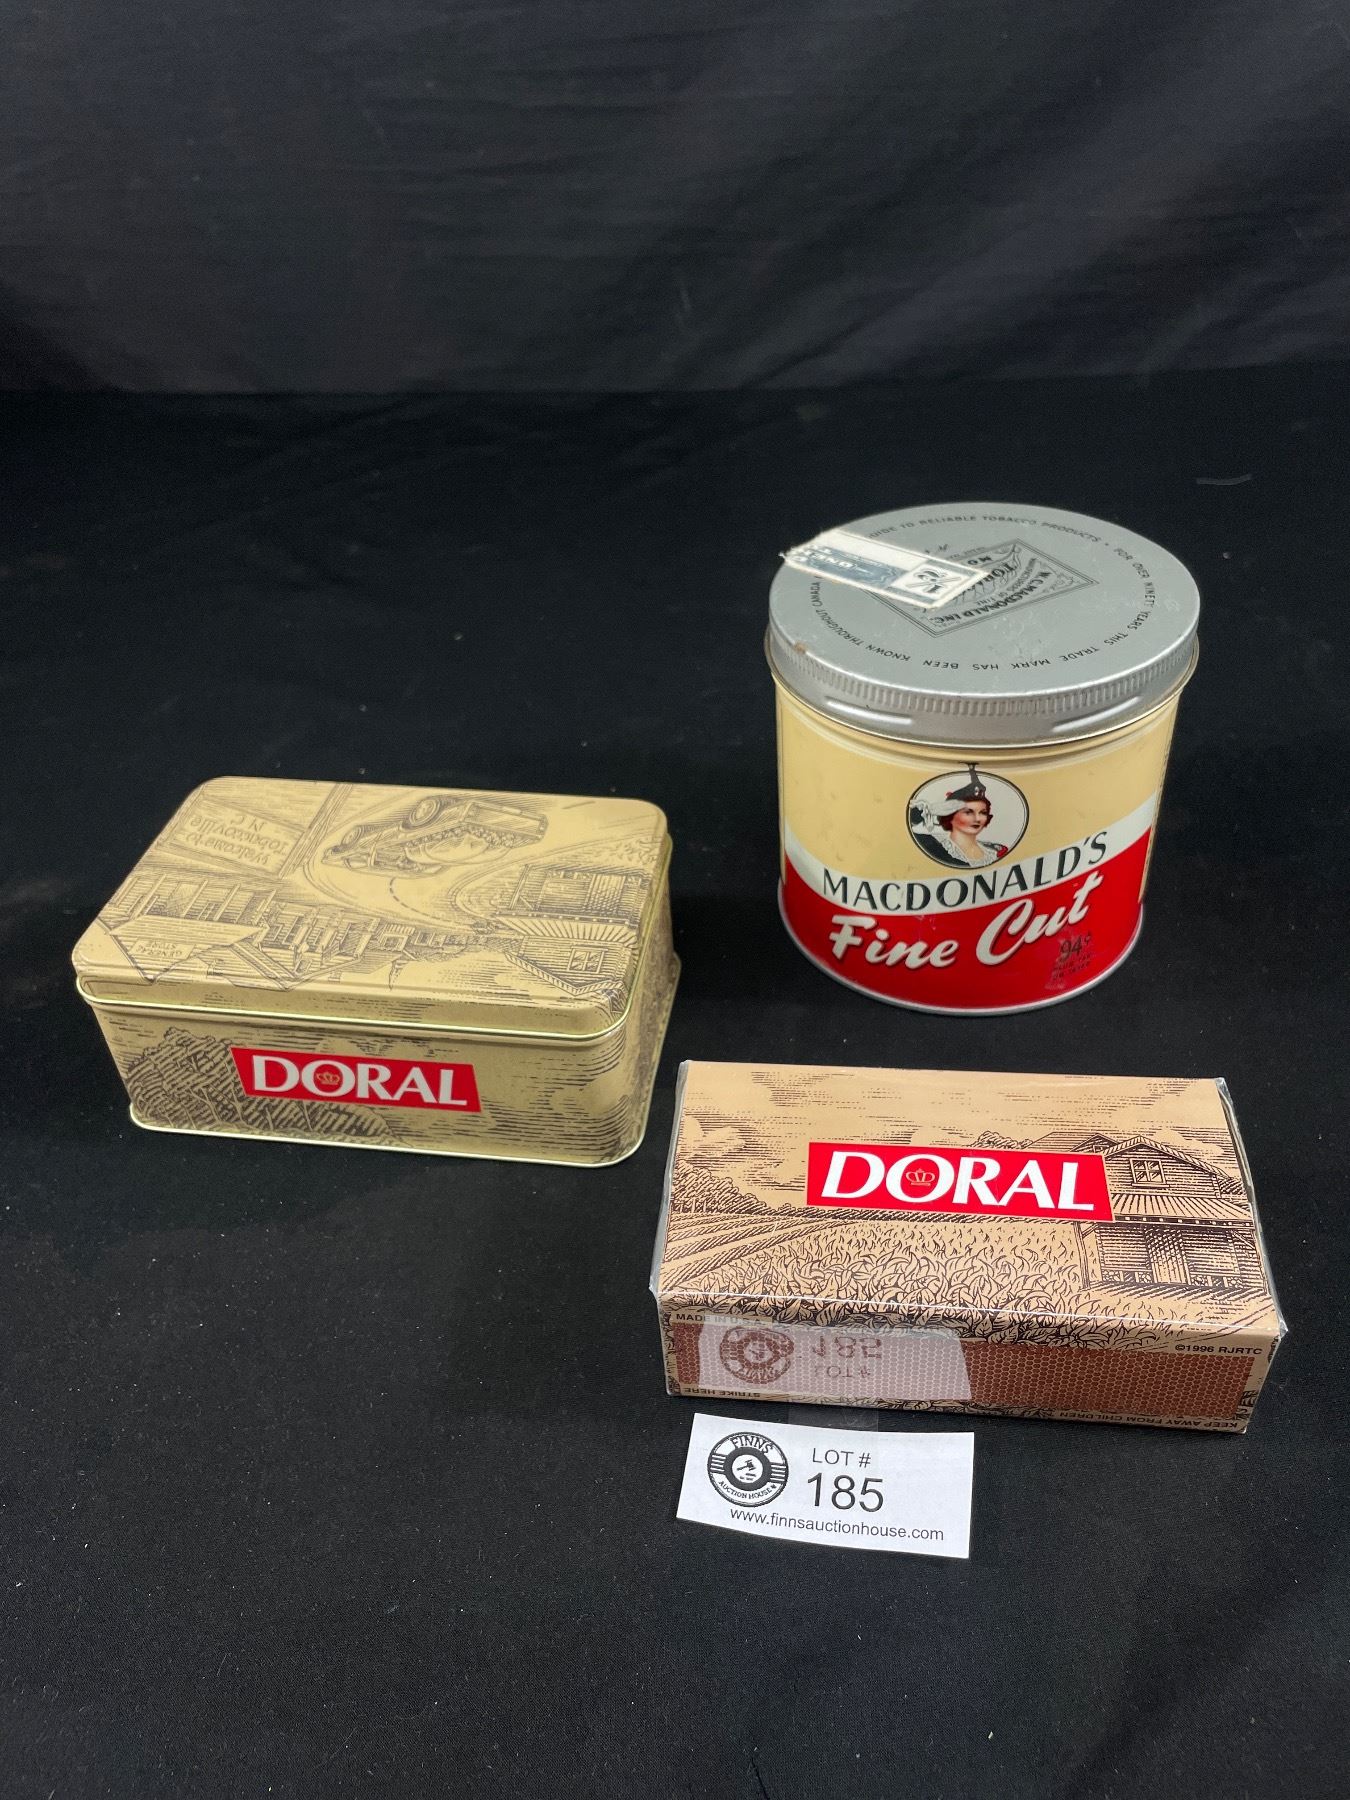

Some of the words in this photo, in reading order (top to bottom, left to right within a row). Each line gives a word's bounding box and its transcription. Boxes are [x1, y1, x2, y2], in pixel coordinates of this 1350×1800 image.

[919, 515, 976, 526] RELIABLE
[982, 515, 1037, 525] TOBACCO
[1041, 522, 1101, 542] PRODUCTS
[1114, 548, 1133, 560] FOR
[1132, 563, 1150, 578] OVER
[810, 581, 823, 607] CANADA
[1144, 582, 1156, 608] NINETY
[815, 609, 865, 646] THROUGHOUT
[1127, 611, 1151, 630] YEARS
[1103, 632, 1128, 645] THIS
[865, 644, 911, 661] KNOWN
[1059, 646, 1100, 662] TRADE
[923, 660, 959, 670] BEEN
[972, 663, 999, 671] HAS
[1011, 658, 1051, 670] MARK
[822, 830, 1108, 913] MACDONALD'S
[828, 913, 960, 970] Fine
[975, 870, 1104, 967] Cut
[251, 1055, 468, 1106] DORAL
[820, 1150, 1094, 1211] DORAL
[1218, 1345, 1263, 1356] RJRTC
[684, 1387, 715, 1395] HERE
[719, 1390, 760, 1398] STRIKE
[1060, 1412, 1123, 1422] CHILDREN
[1126, 1417, 1162, 1426] FROM
[1166, 1418, 1202, 1426] AWAY
[1204, 1419, 1238, 1429] KEEP
[729, 1434, 774, 1454] FINNS
[811, 1447, 855, 1466] LOT
[858, 1452, 872, 1468] #
[718, 1480, 748, 1499] AUCTION
[748, 1487, 773, 1500] HOUSE
[807, 1472, 884, 1513] 185
[730, 1508, 944, 1541] www.finnsauctionhouse.com
